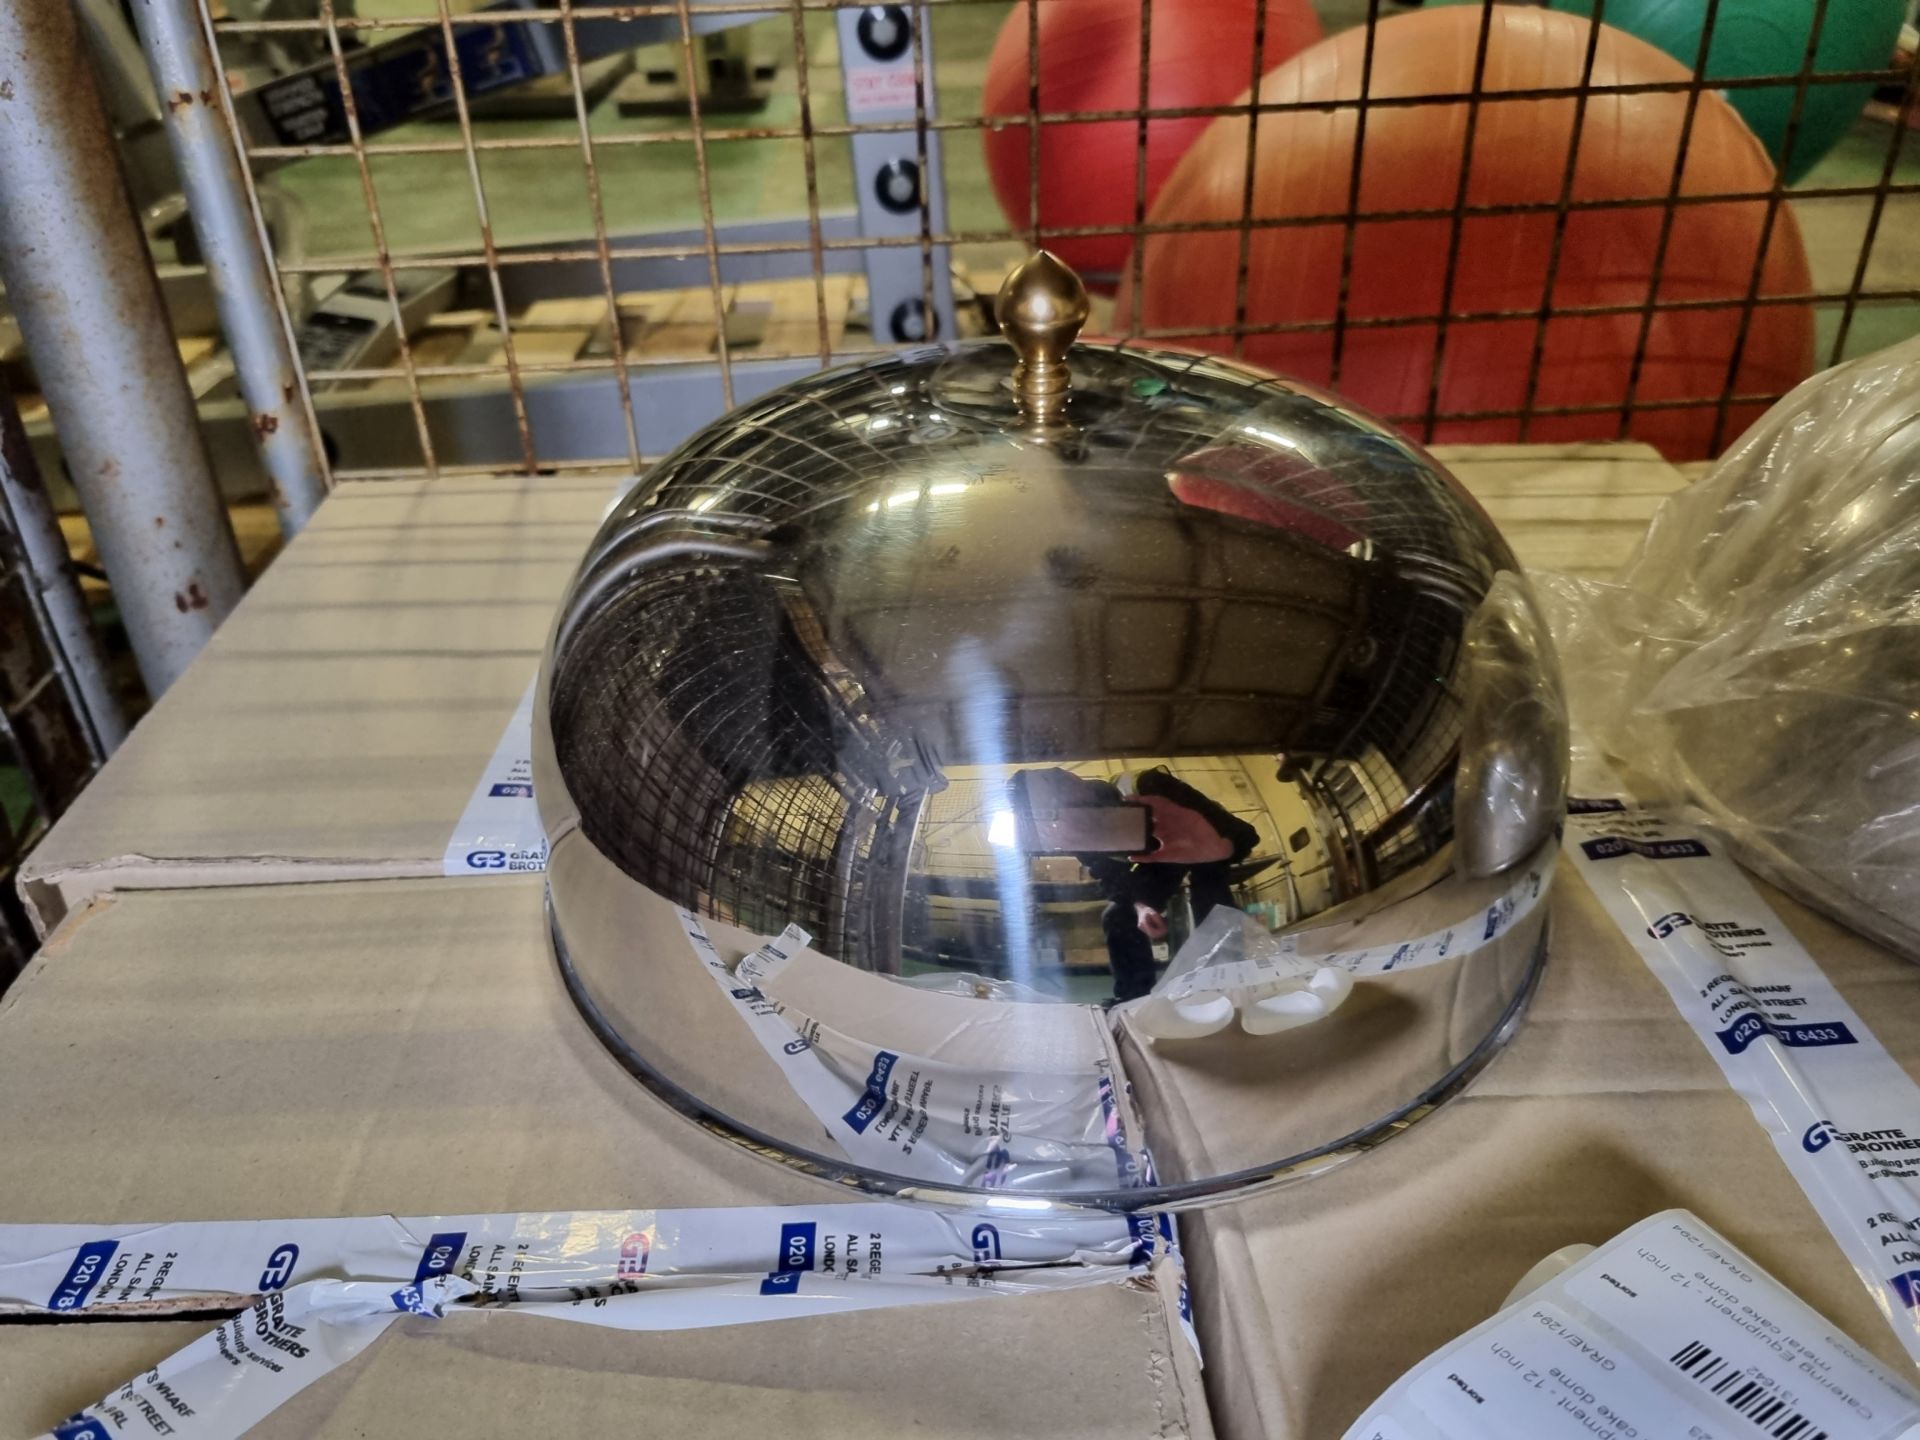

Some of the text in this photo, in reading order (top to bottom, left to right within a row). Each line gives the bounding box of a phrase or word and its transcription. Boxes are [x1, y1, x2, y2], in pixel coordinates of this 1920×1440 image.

[1711, 993, 1729, 1011] ALL
[1762, 997, 1808, 1007] STREET
[1734, 1018, 1761, 1043] 020
[1796, 1028, 1839, 1041] 6433
[870, 1232, 882, 1240] 2
[1867, 1216, 1878, 1229] 2
[428, 1245, 453, 1269] 020
[488, 1244, 506, 1263] ALL
[789, 1236, 807, 1266] 020
[846, 1233, 859, 1256] ALL
[1672, 1224, 1753, 1283] GRAE/1294
[134, 1252, 155, 1274] ALL
[1637, 1248, 1671, 1272] inch
[57, 1255, 102, 1311] 020 78
[95, 1253, 132, 1299] LONDON
[1600, 1273, 1638, 1298] sorted
[1670, 1272, 1692, 1288] 12
[400, 1284, 425, 1315] 433
[267, 1292, 307, 1338] GRATTE
[1694, 1271, 1832, 1372] metal cake dome
[1704, 1295, 1796, 1363] Equipment
[215, 1326, 242, 1366] ngineers
[1532, 1310, 1616, 1371] GRAE/1294
[246, 1350, 284, 1373] services
[1490, 1342, 1525, 1370] inch
[1447, 1373, 1485, 1404] sorted
[1522, 1370, 1545, 1388] 12
[1746, 1366, 1800, 1406] 131642
[1799, 1362, 1873, 1420] Catering
[153, 1381, 196, 1419] WHARF
[1549, 1367, 1638, 1438] cake dome
